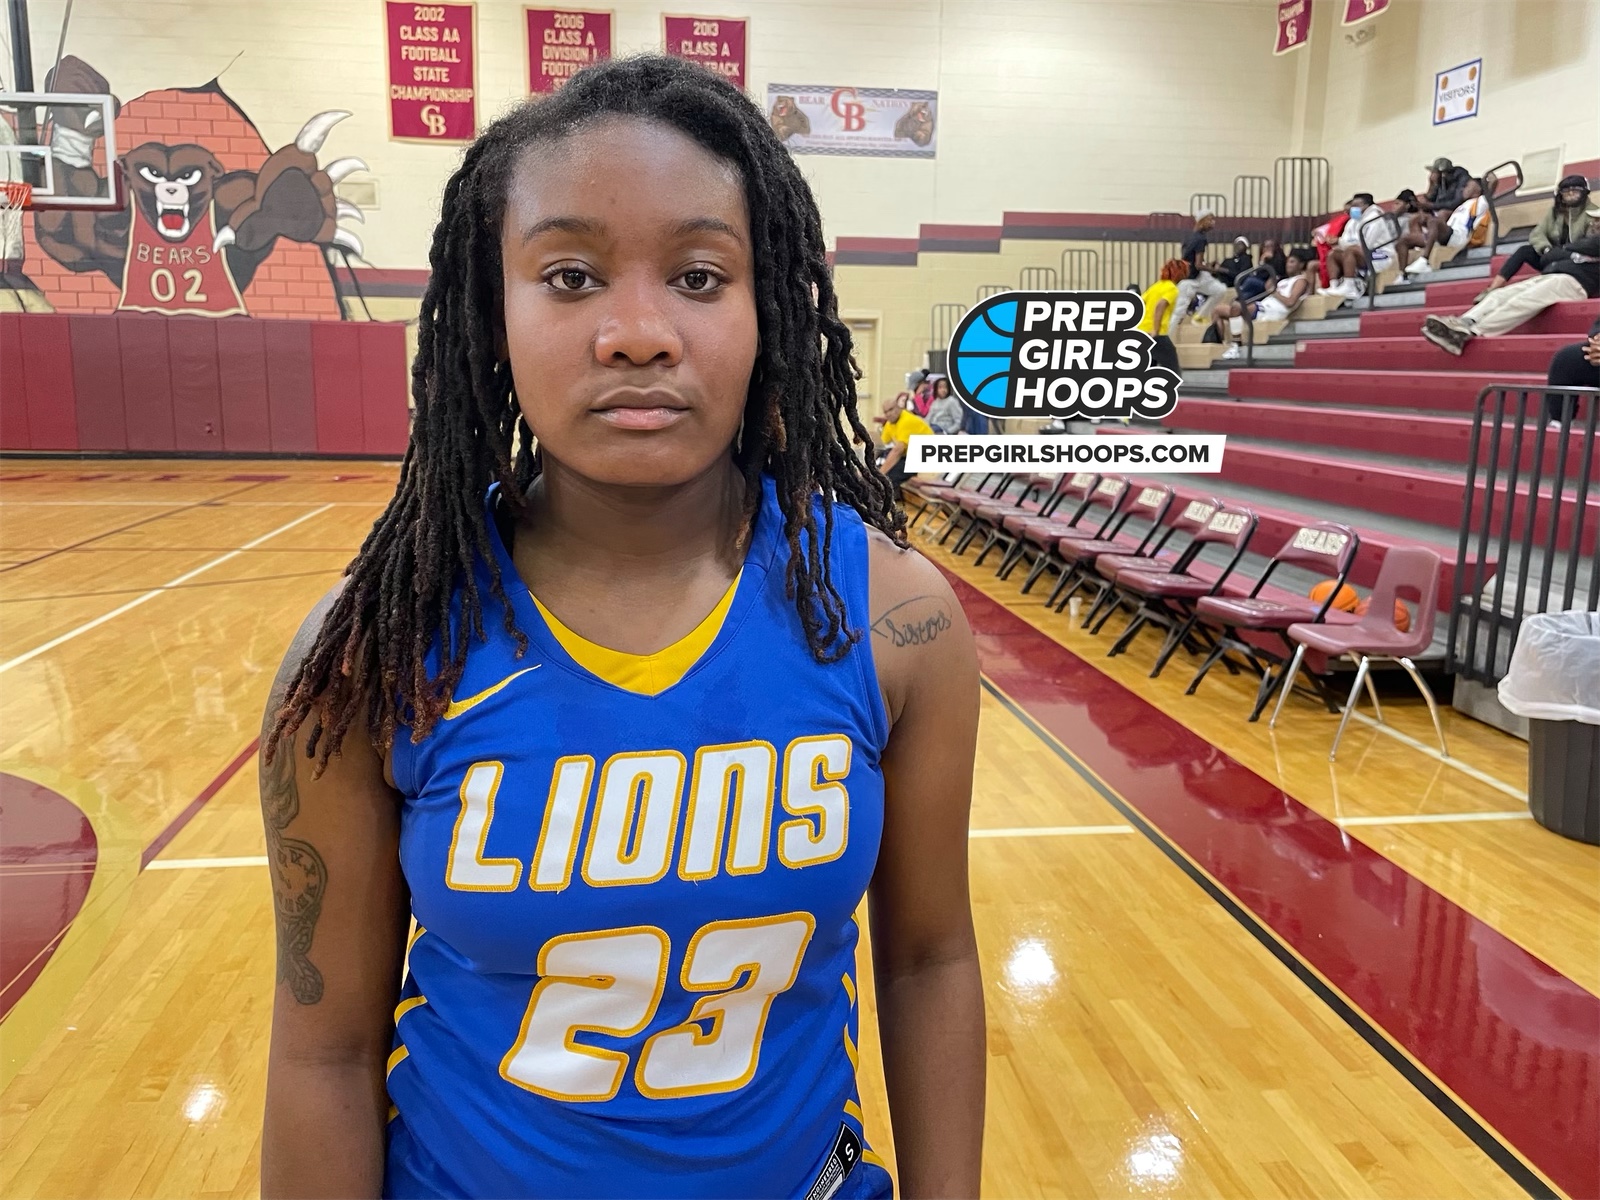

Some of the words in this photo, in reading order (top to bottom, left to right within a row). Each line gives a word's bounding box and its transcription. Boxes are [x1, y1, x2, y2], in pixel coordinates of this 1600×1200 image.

[414, 6, 445, 22] 2002
[400, 26, 439, 42] CLASS
[442, 28, 460, 43] AA
[544, 28, 581, 45] CLASS
[585, 31, 595, 46] A
[693, 21, 719, 36] 2013
[401, 46, 461, 63] FOOTBALL
[542, 45, 589, 61] DIVISION
[681, 40, 718, 56] CLASS
[721, 42, 731, 56] A
[413, 66, 450, 83] STATE
[391, 84, 474, 103] CHAMPIONSHIP
[1439, 83, 1476, 102] VISITORS
[137, 243, 211, 264] BEARS
[151, 268, 208, 302] 02
[445, 733, 852, 893] LIONS
[499, 911, 816, 1102] 23
[845, 1142, 854, 1162] S
